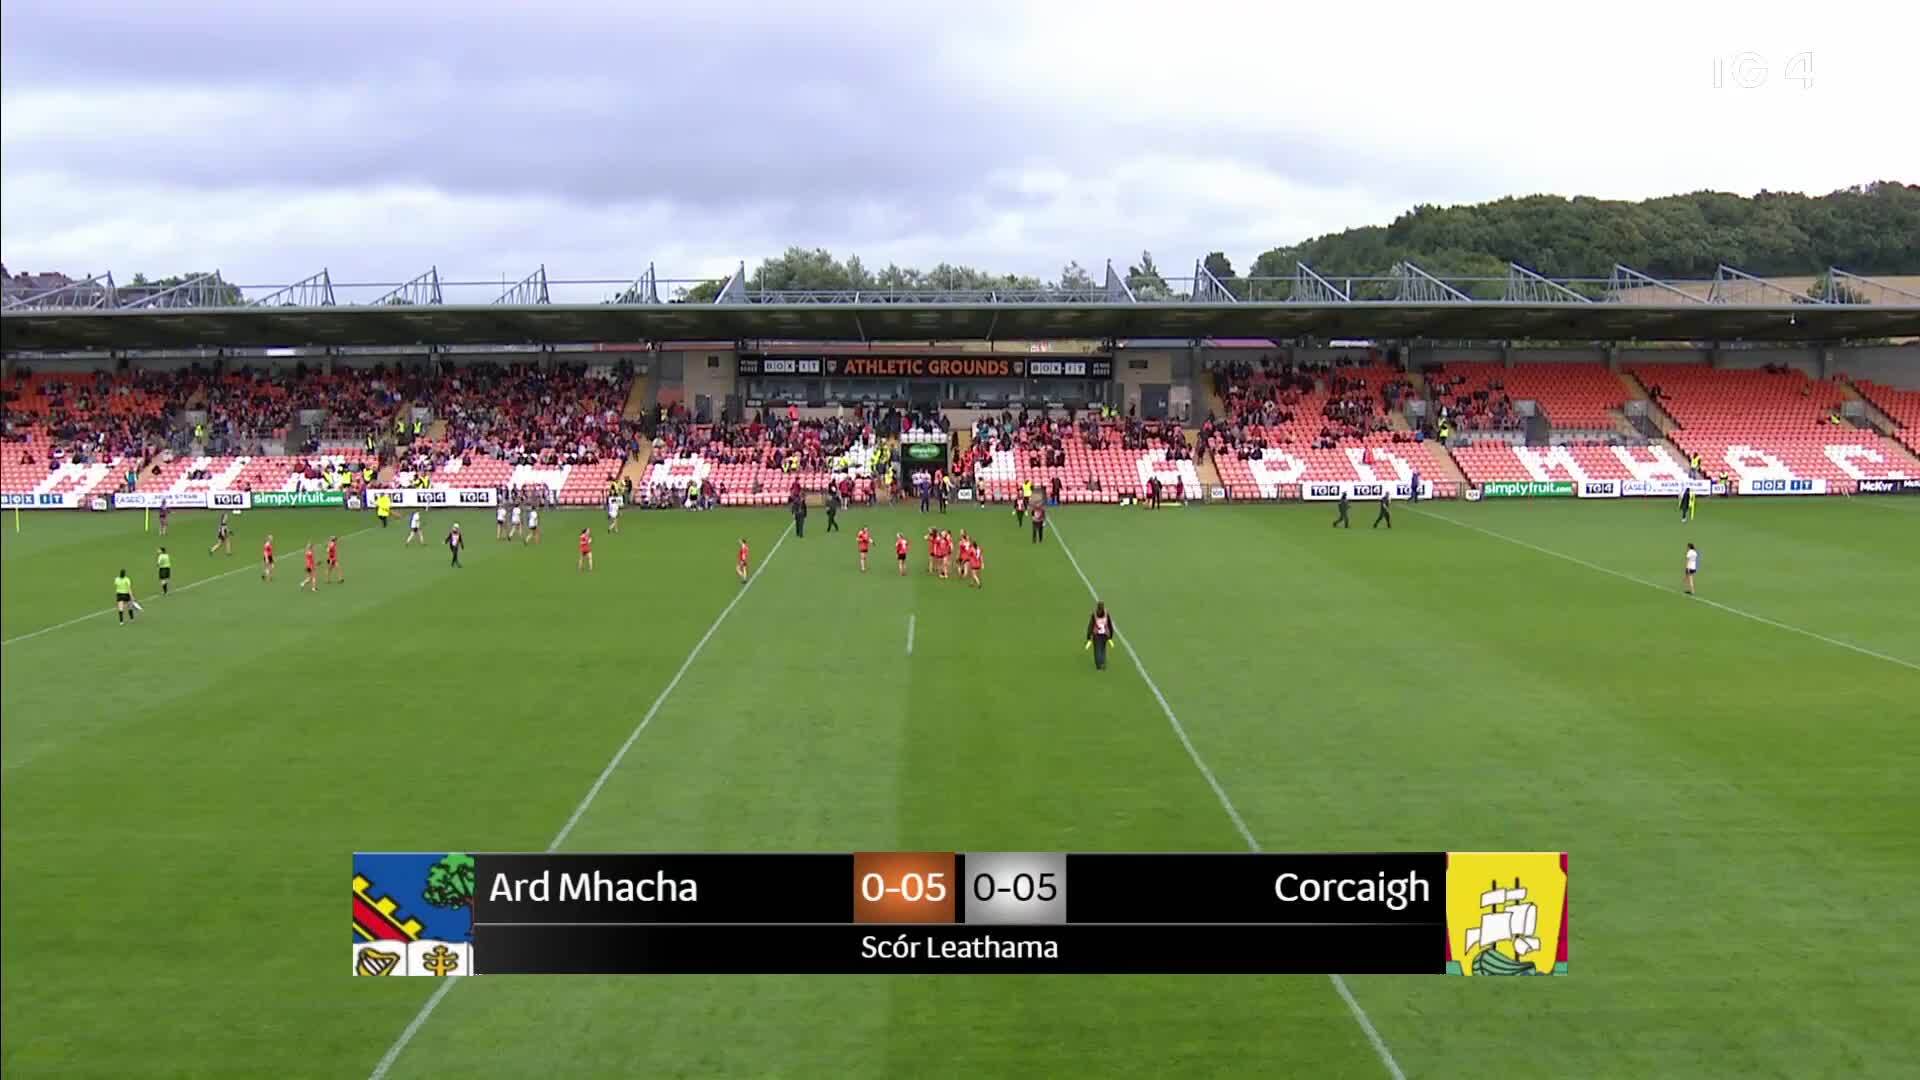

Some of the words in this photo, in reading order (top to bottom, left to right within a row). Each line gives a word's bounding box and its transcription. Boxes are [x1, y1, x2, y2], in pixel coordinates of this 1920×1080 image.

[844, 360, 923, 374] ATHLETIC
[928, 360, 1009, 374] GROUNDS
[1586, 483, 1613, 493] TG4
[1752, 480, 1785, 490] BOX
[1790, 480, 1812, 490] IT
[1311, 486, 1340, 496] TG4
[1354, 486, 1383, 496] TG4
[215, 495, 242, 505] TG4
[417, 493, 446, 502] TG4
[460, 493, 489, 502] TG4
